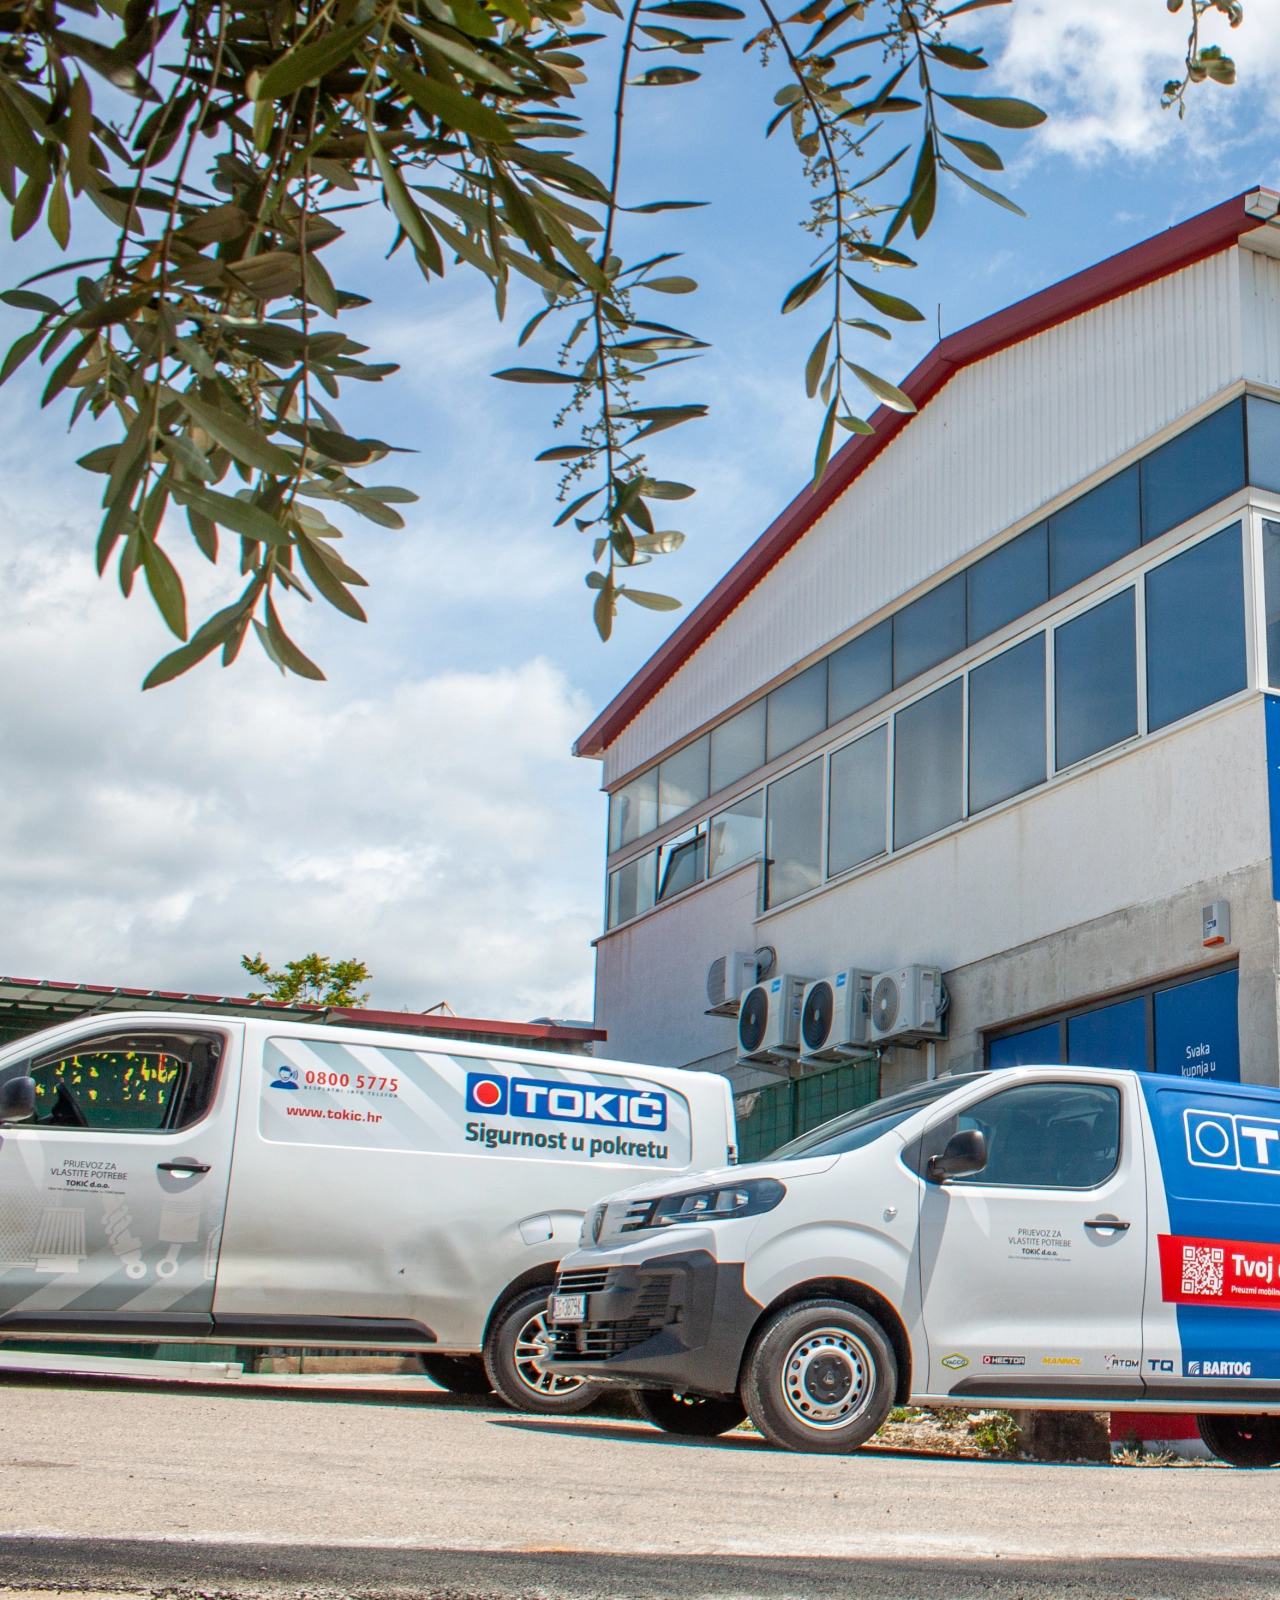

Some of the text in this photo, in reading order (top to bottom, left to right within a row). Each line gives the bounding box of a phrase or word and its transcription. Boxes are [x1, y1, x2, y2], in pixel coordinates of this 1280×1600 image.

[1186, 1043, 1210, 1059] Svaka
[1181, 1061, 1216, 1078] kupnja u
[305, 1070, 399, 1092] 0800 5775
[515, 1084, 662, 1126] TOKIĆ
[286, 1107, 383, 1123] www.tokic.hr
[466, 1122, 669, 1159] Sigurnost u pokretu
[63, 1159, 117, 1170] PRIJEVOZ ZA
[51, 1168, 128, 1180] VLASTITE POTREBE
[66, 1179, 110, 1189] TOKIĆ d.o.o.
[1018, 1228, 1062, 1238] PRIJEVOZ ZA
[1008, 1236, 1072, 1248] VLASTITE POTREBE
[1231, 1254, 1273, 1284] Tvoj
[1231, 1285, 1257, 1295] Preuzmi
[991, 1356, 1025, 1365] HECTOR
[1042, 1357, 1083, 1365] MANNOL
[1112, 1359, 1139, 1367] ATOM
[1148, 1358, 1174, 1373] TQ
[1203, 1361, 1251, 1375] BARTOG
